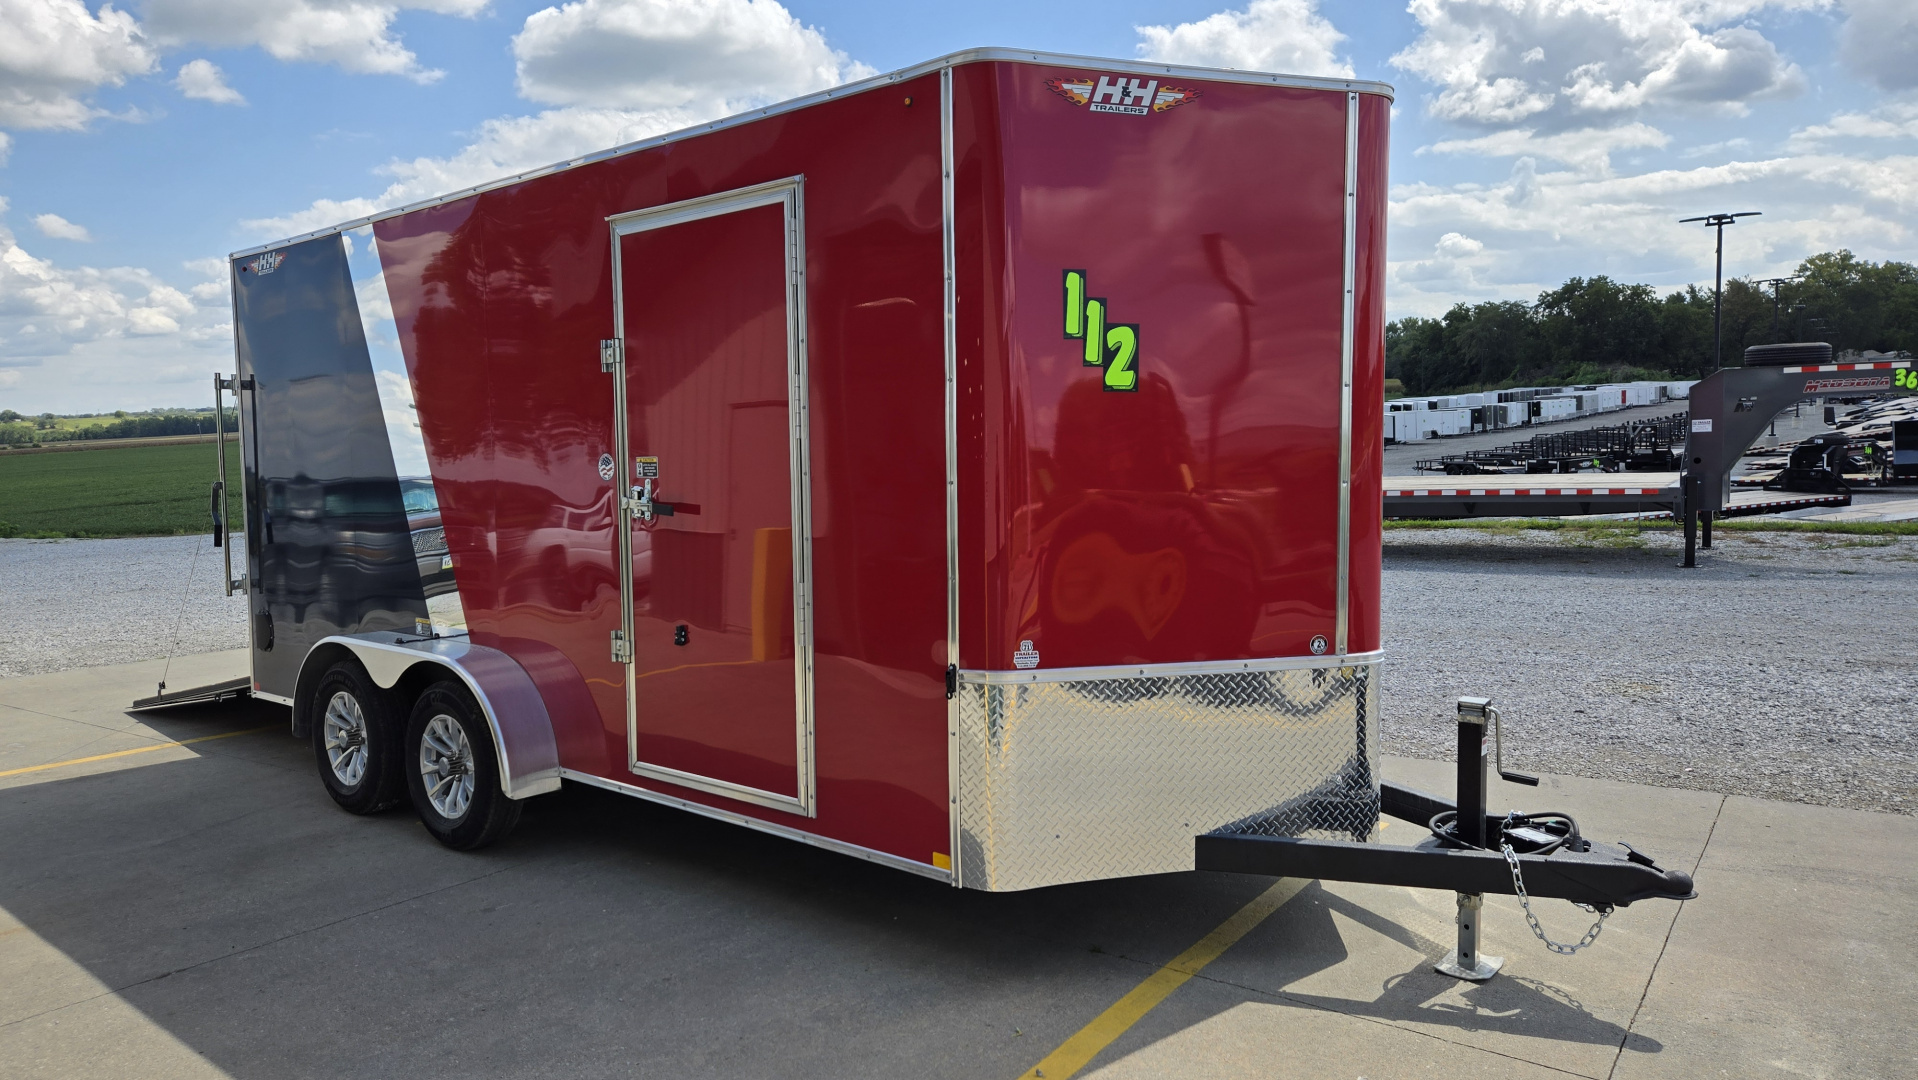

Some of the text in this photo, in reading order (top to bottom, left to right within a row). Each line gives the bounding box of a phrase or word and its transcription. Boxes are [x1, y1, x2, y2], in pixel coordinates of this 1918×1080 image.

[1092, 75, 1158, 107] H&H
[1094, 104, 1144, 114] TRAILERS
[1066, 271, 1136, 389] 112
[1895, 368, 1918, 391] 36
